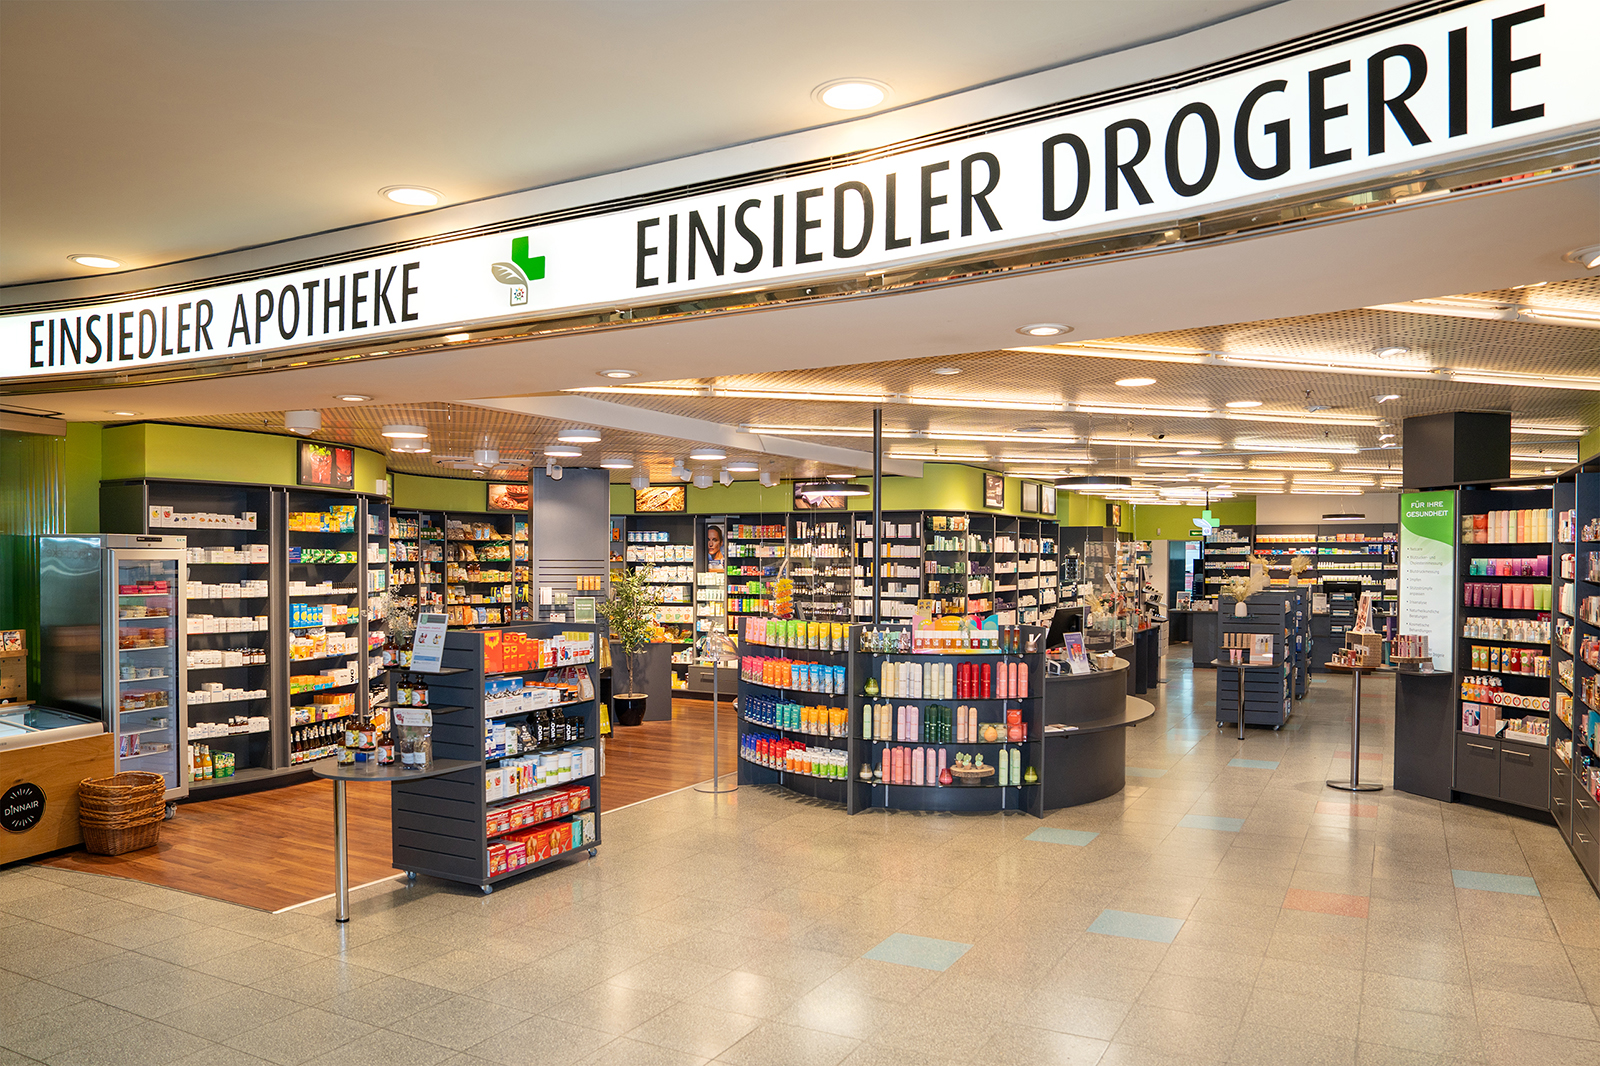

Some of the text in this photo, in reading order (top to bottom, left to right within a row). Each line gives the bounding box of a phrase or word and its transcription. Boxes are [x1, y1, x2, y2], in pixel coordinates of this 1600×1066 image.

[635, 4, 1545, 289] EINSIEDLER DROGERIE
[30, 262, 420, 368] EINSIEDLER APOTHEKE
[1410, 500, 1425, 508] FÜR
[1406, 510, 1449, 518] GESUNDHEIT
[4, 801, 39, 816] DINNAIR
